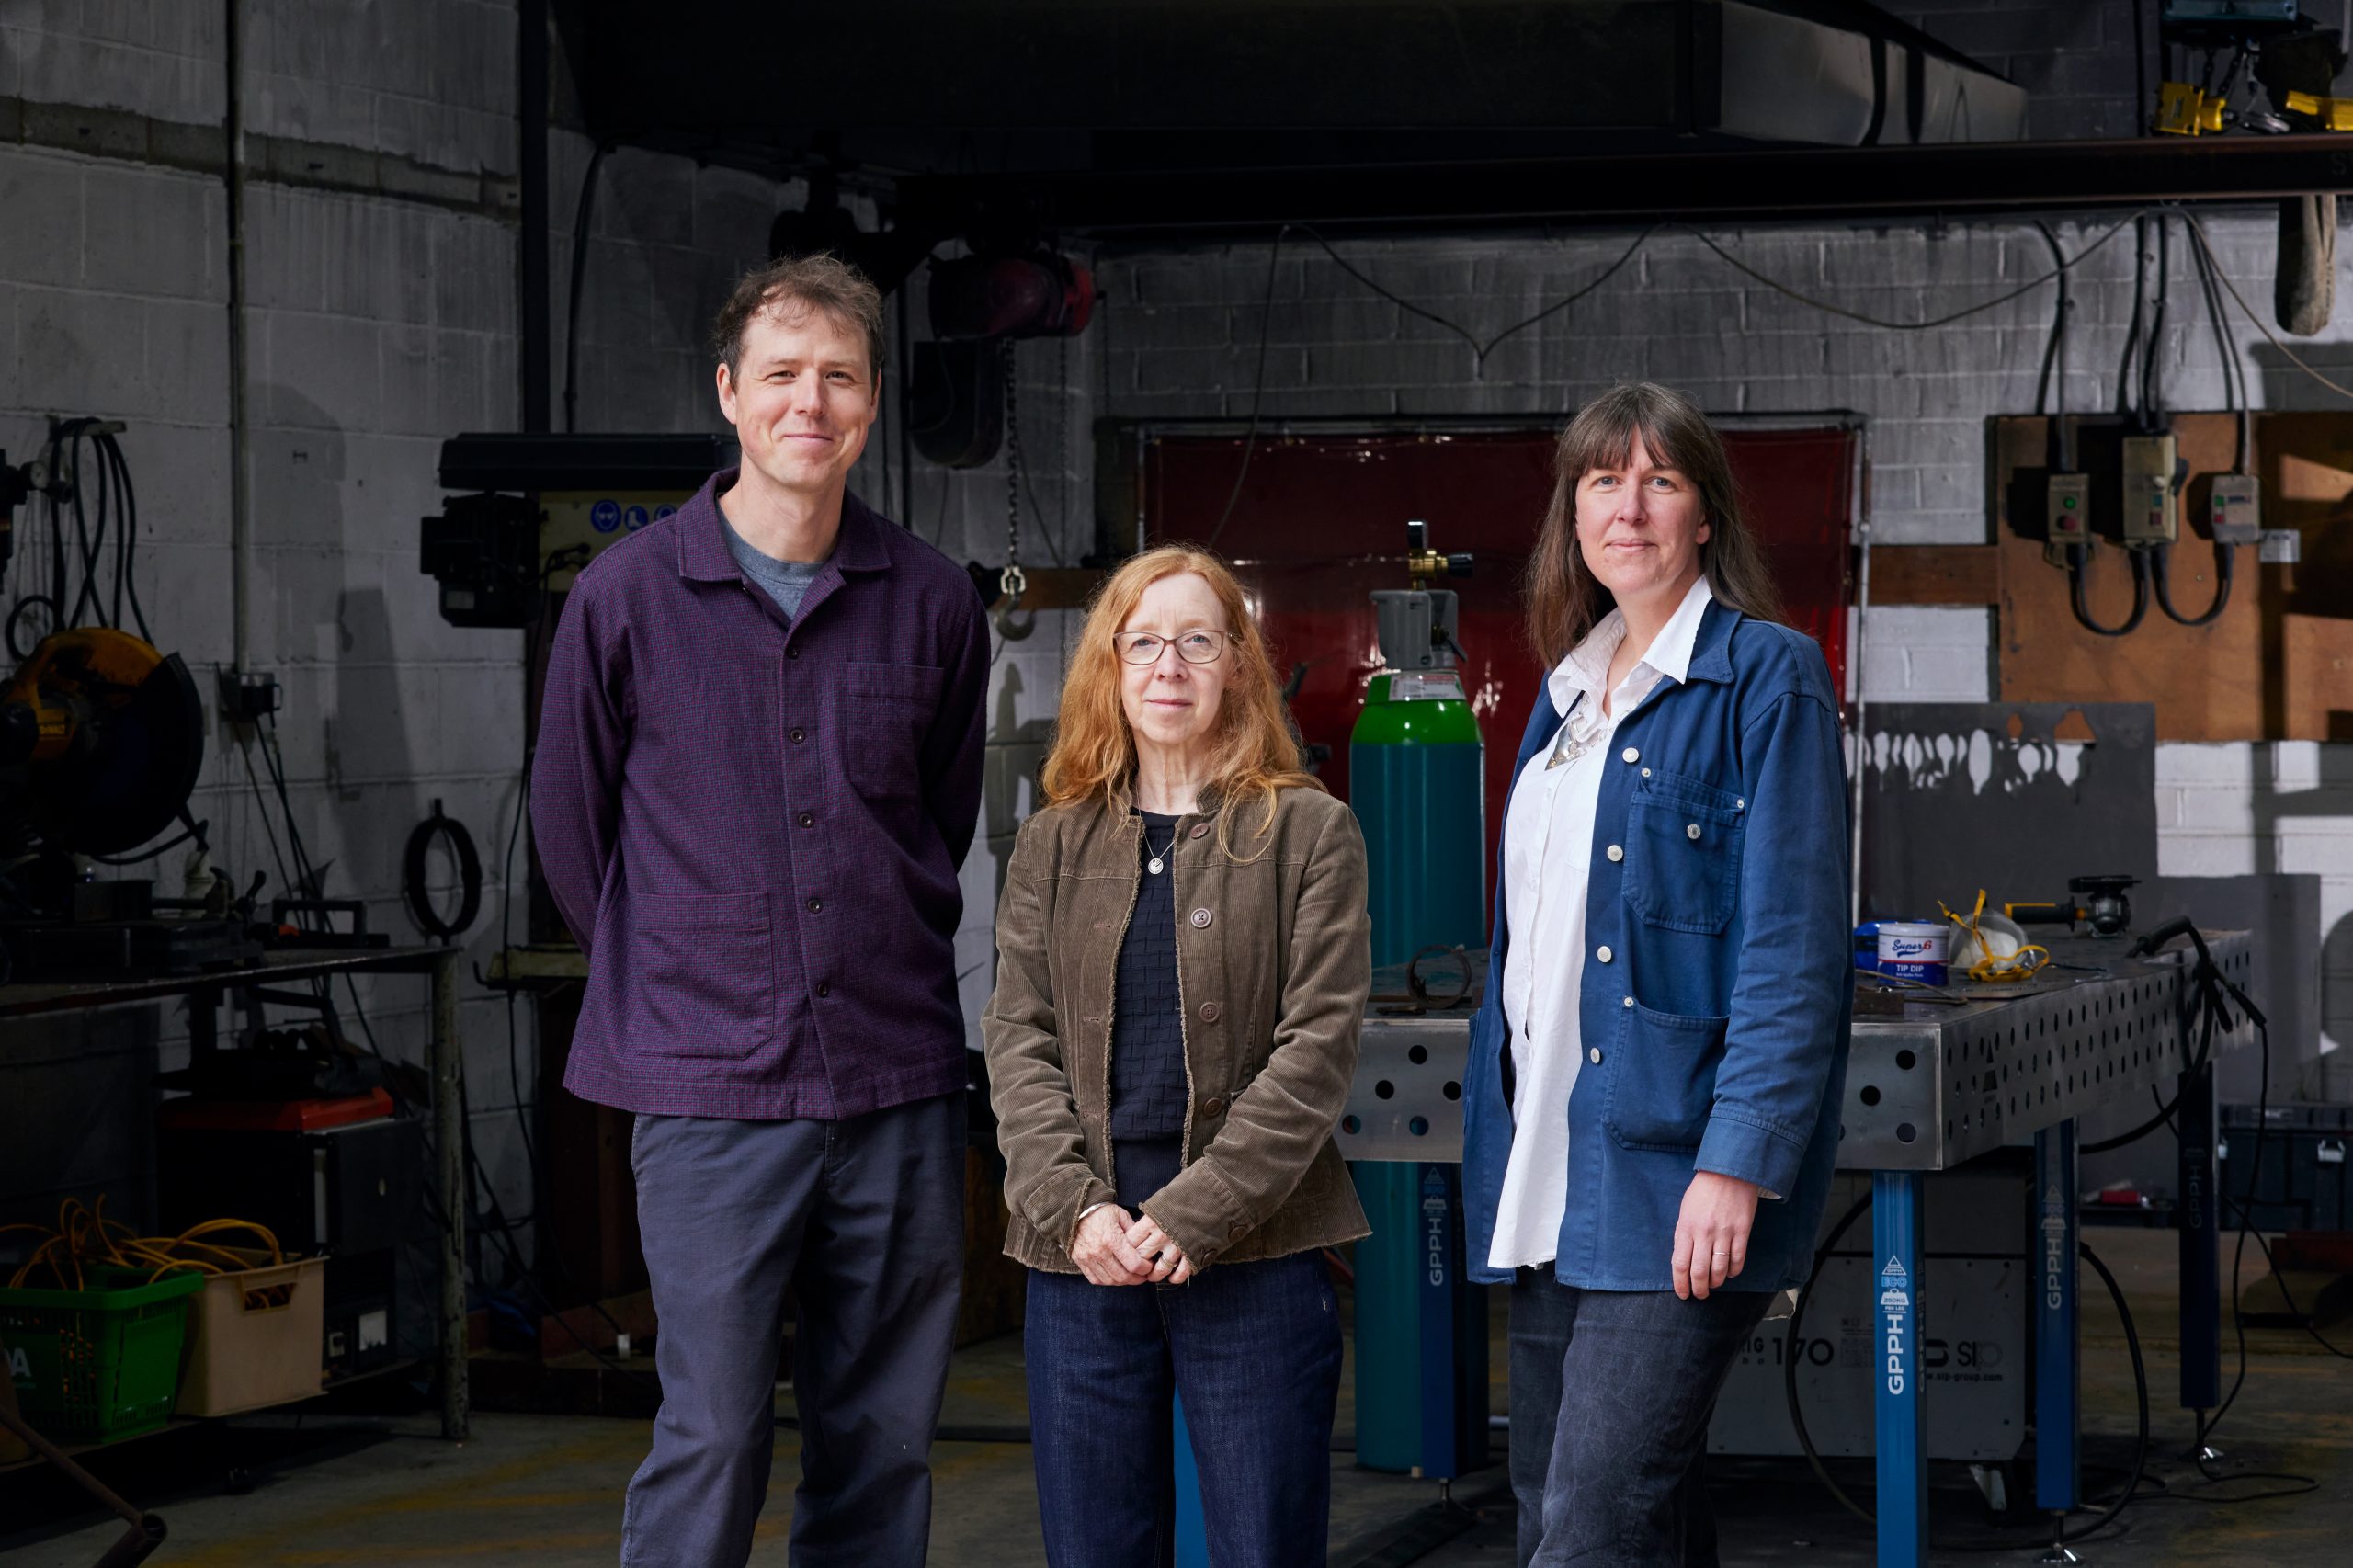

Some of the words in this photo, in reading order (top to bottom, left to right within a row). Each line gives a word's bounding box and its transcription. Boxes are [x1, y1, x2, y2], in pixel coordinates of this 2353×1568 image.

[1896, 964, 1909, 972] TIP
[1910, 965, 1924, 973] DIP
[2189, 1165, 2202, 1229] GPPH
[1428, 1217, 1444, 1287] GPPH
[1881, 1276, 1907, 1288] ECO
[2047, 1238, 2063, 1310] GPPH
[1772, 1337, 1835, 1366] 170
[1887, 1314, 1904, 1395] GPPH
